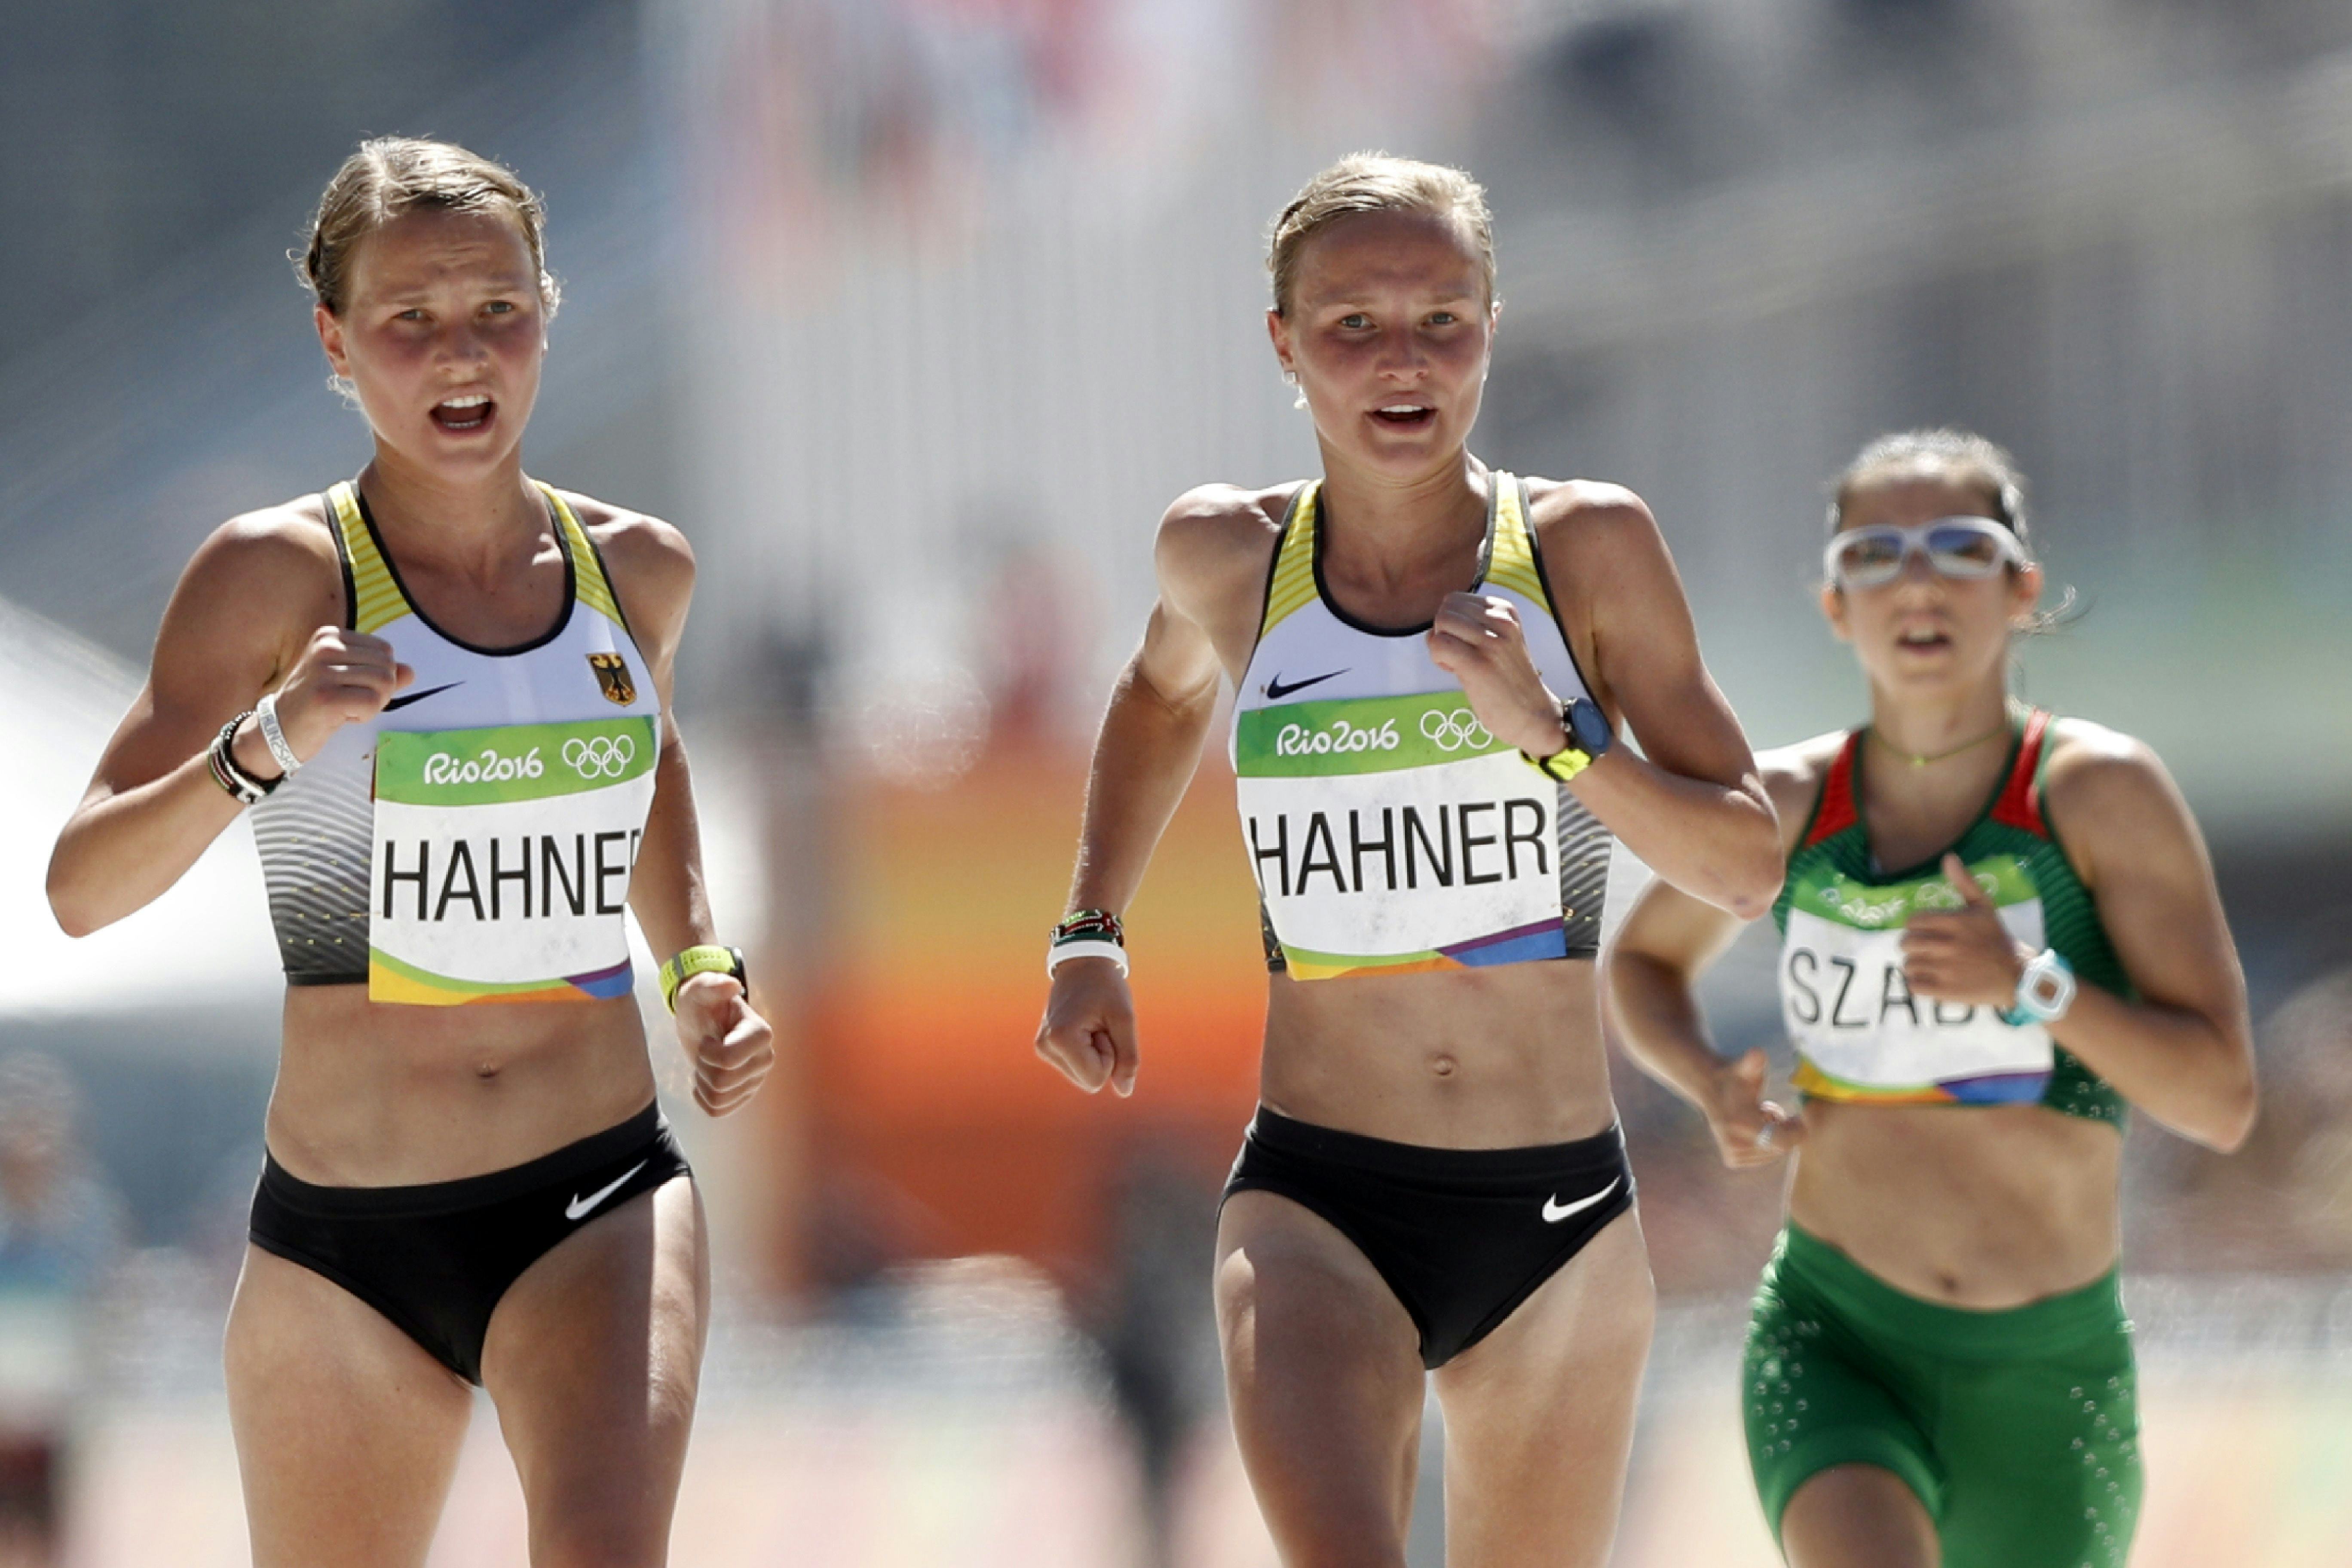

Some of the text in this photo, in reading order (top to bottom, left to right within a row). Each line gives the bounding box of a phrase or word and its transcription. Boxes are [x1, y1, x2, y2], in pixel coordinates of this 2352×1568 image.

[383, 828, 641, 921] HAHNE
[1249, 798, 1549, 897] HAHNER
[1788, 948, 2012, 1029] SZA
